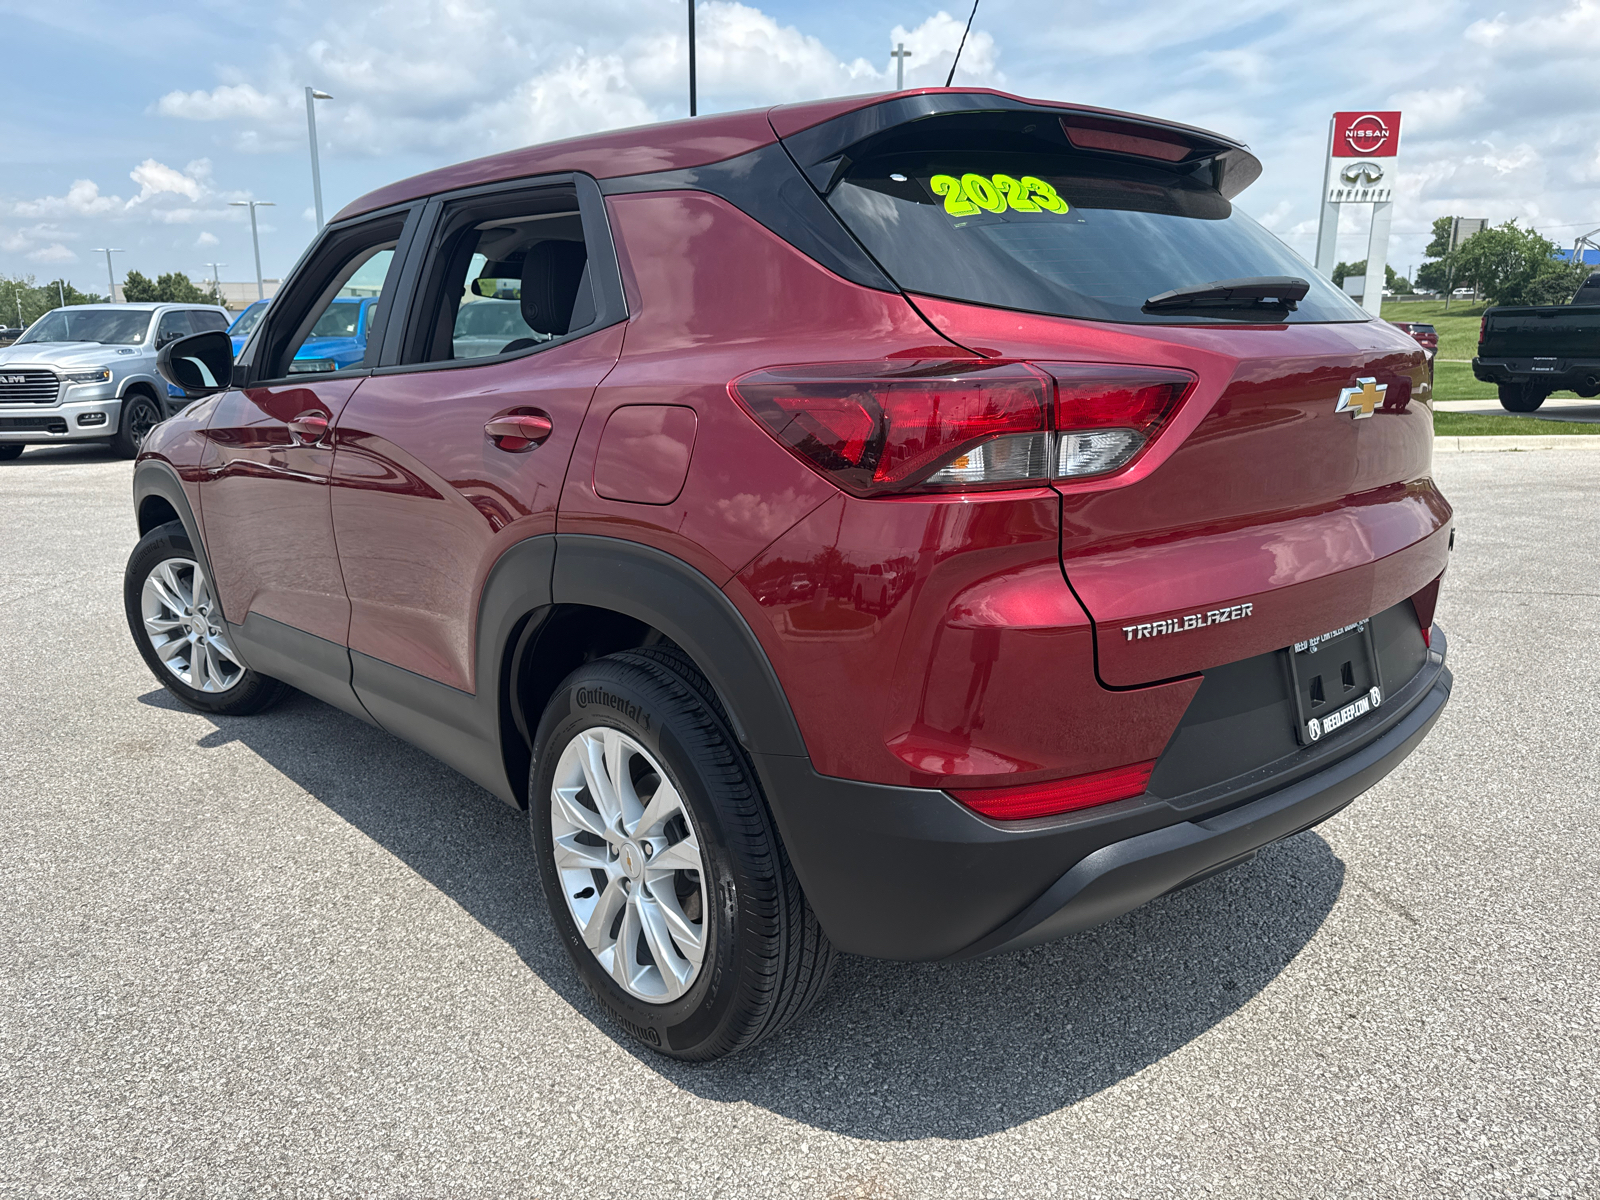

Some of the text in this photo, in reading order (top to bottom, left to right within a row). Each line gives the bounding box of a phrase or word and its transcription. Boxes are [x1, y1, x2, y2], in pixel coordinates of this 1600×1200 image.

[930, 173, 1068, 217] 2023
[1329, 189, 1391, 199] INFINITI
[0, 375, 26, 383] AM
[1122, 602, 1253, 641] TRAILBLAZER
[576, 686, 643, 724] Continental
[1323, 697, 1370, 734] REEDJEEP.COM
